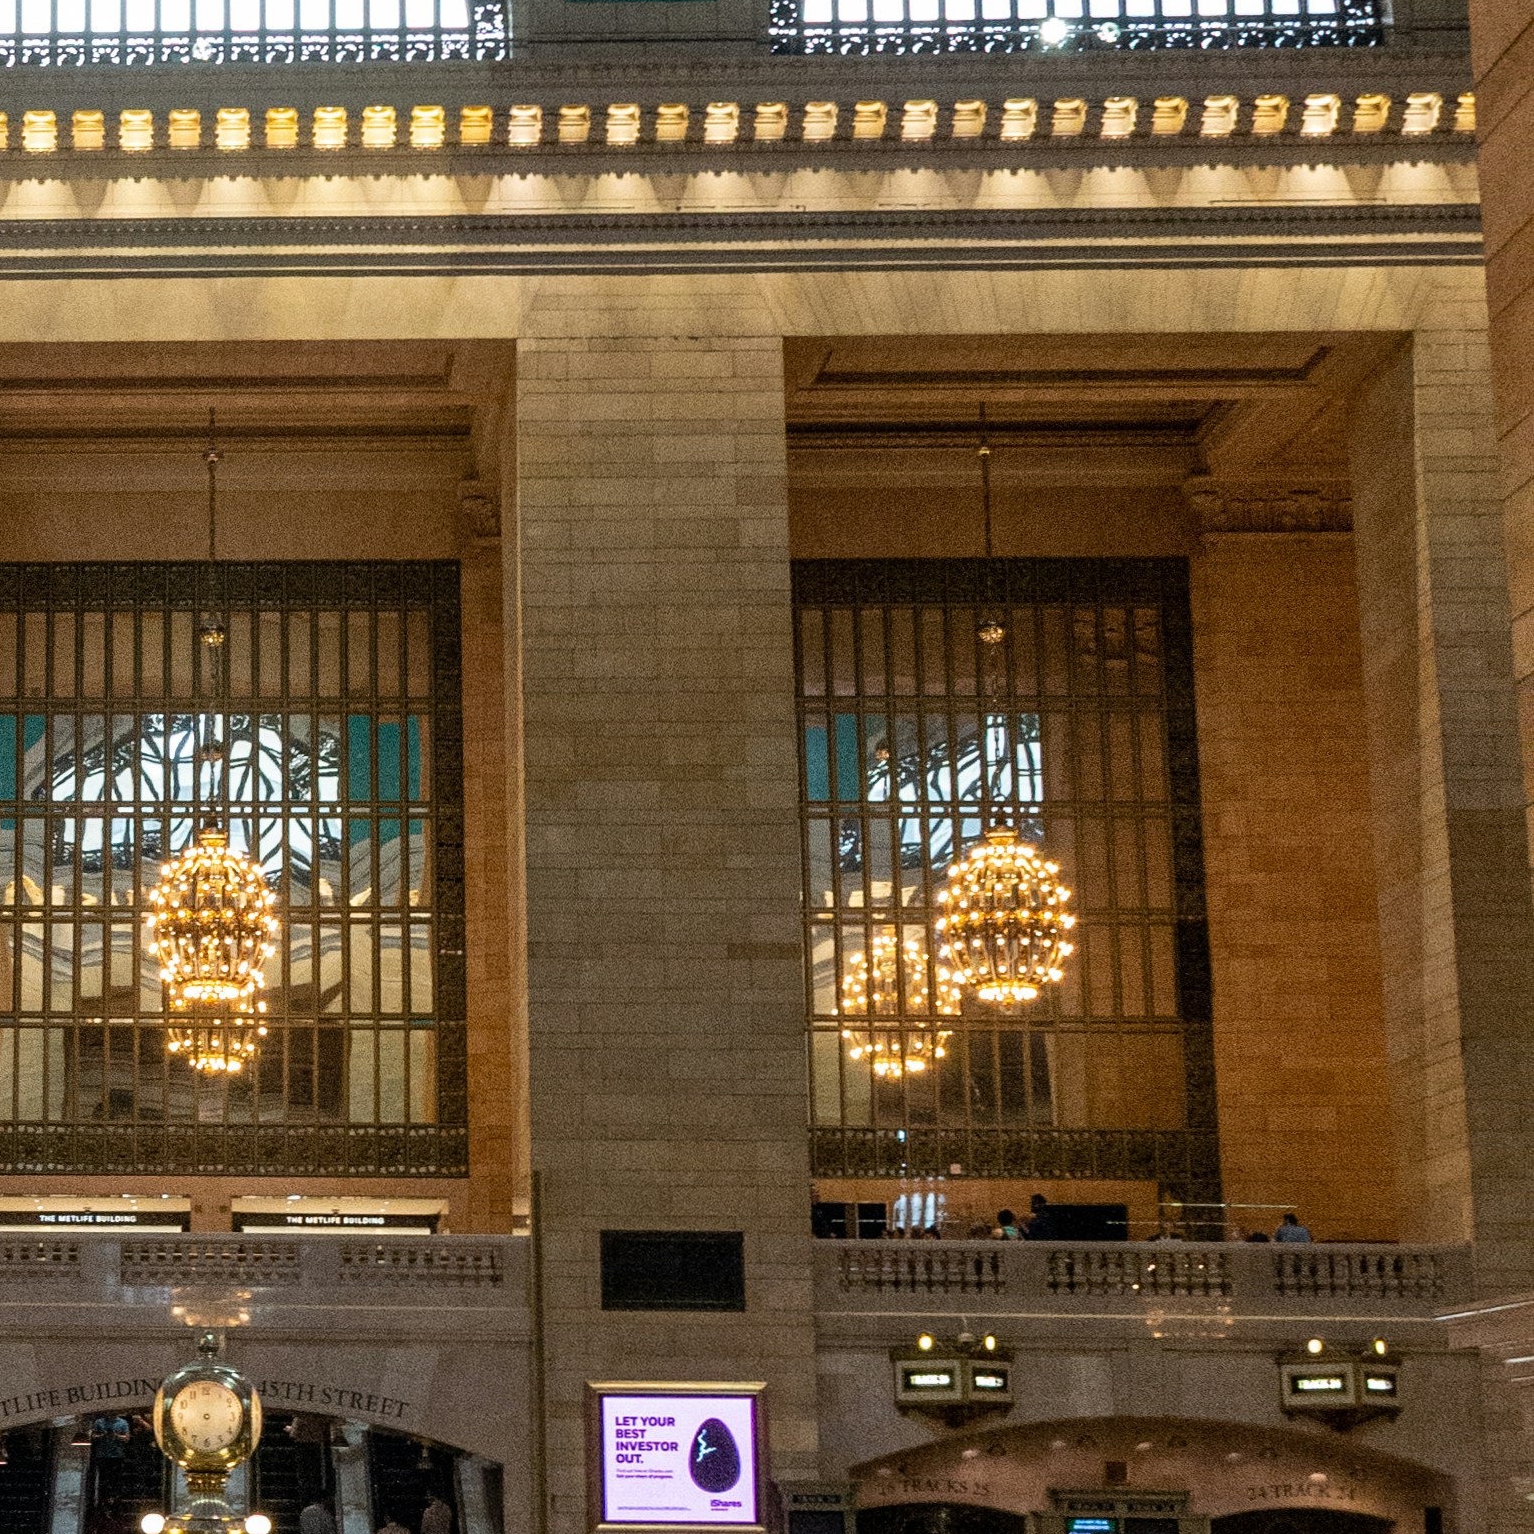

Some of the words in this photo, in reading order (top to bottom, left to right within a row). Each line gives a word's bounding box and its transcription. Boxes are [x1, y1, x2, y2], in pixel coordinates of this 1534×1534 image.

[39, 1214, 56, 1222] THE
[58, 1214, 93, 1222] METLIFE
[96, 1214, 137, 1223] BUILDING
[287, 1216, 303, 1224] THE
[305, 1216, 341, 1224] METLIFE
[343, 1216, 385, 1225] BUILDING
[66, 1377, 165, 1405] BUILDIN
[320, 1385, 410, 1418] STREET
[615, 1416, 638, 1426] LET
[641, 1417, 676, 1426] YOUR
[615, 1429, 647, 1439] BEST
[616, 1441, 679, 1451] INVESTOR
[616, 1454, 644, 1464] OUT.
[899, 1479, 969, 1495] TRACKS
